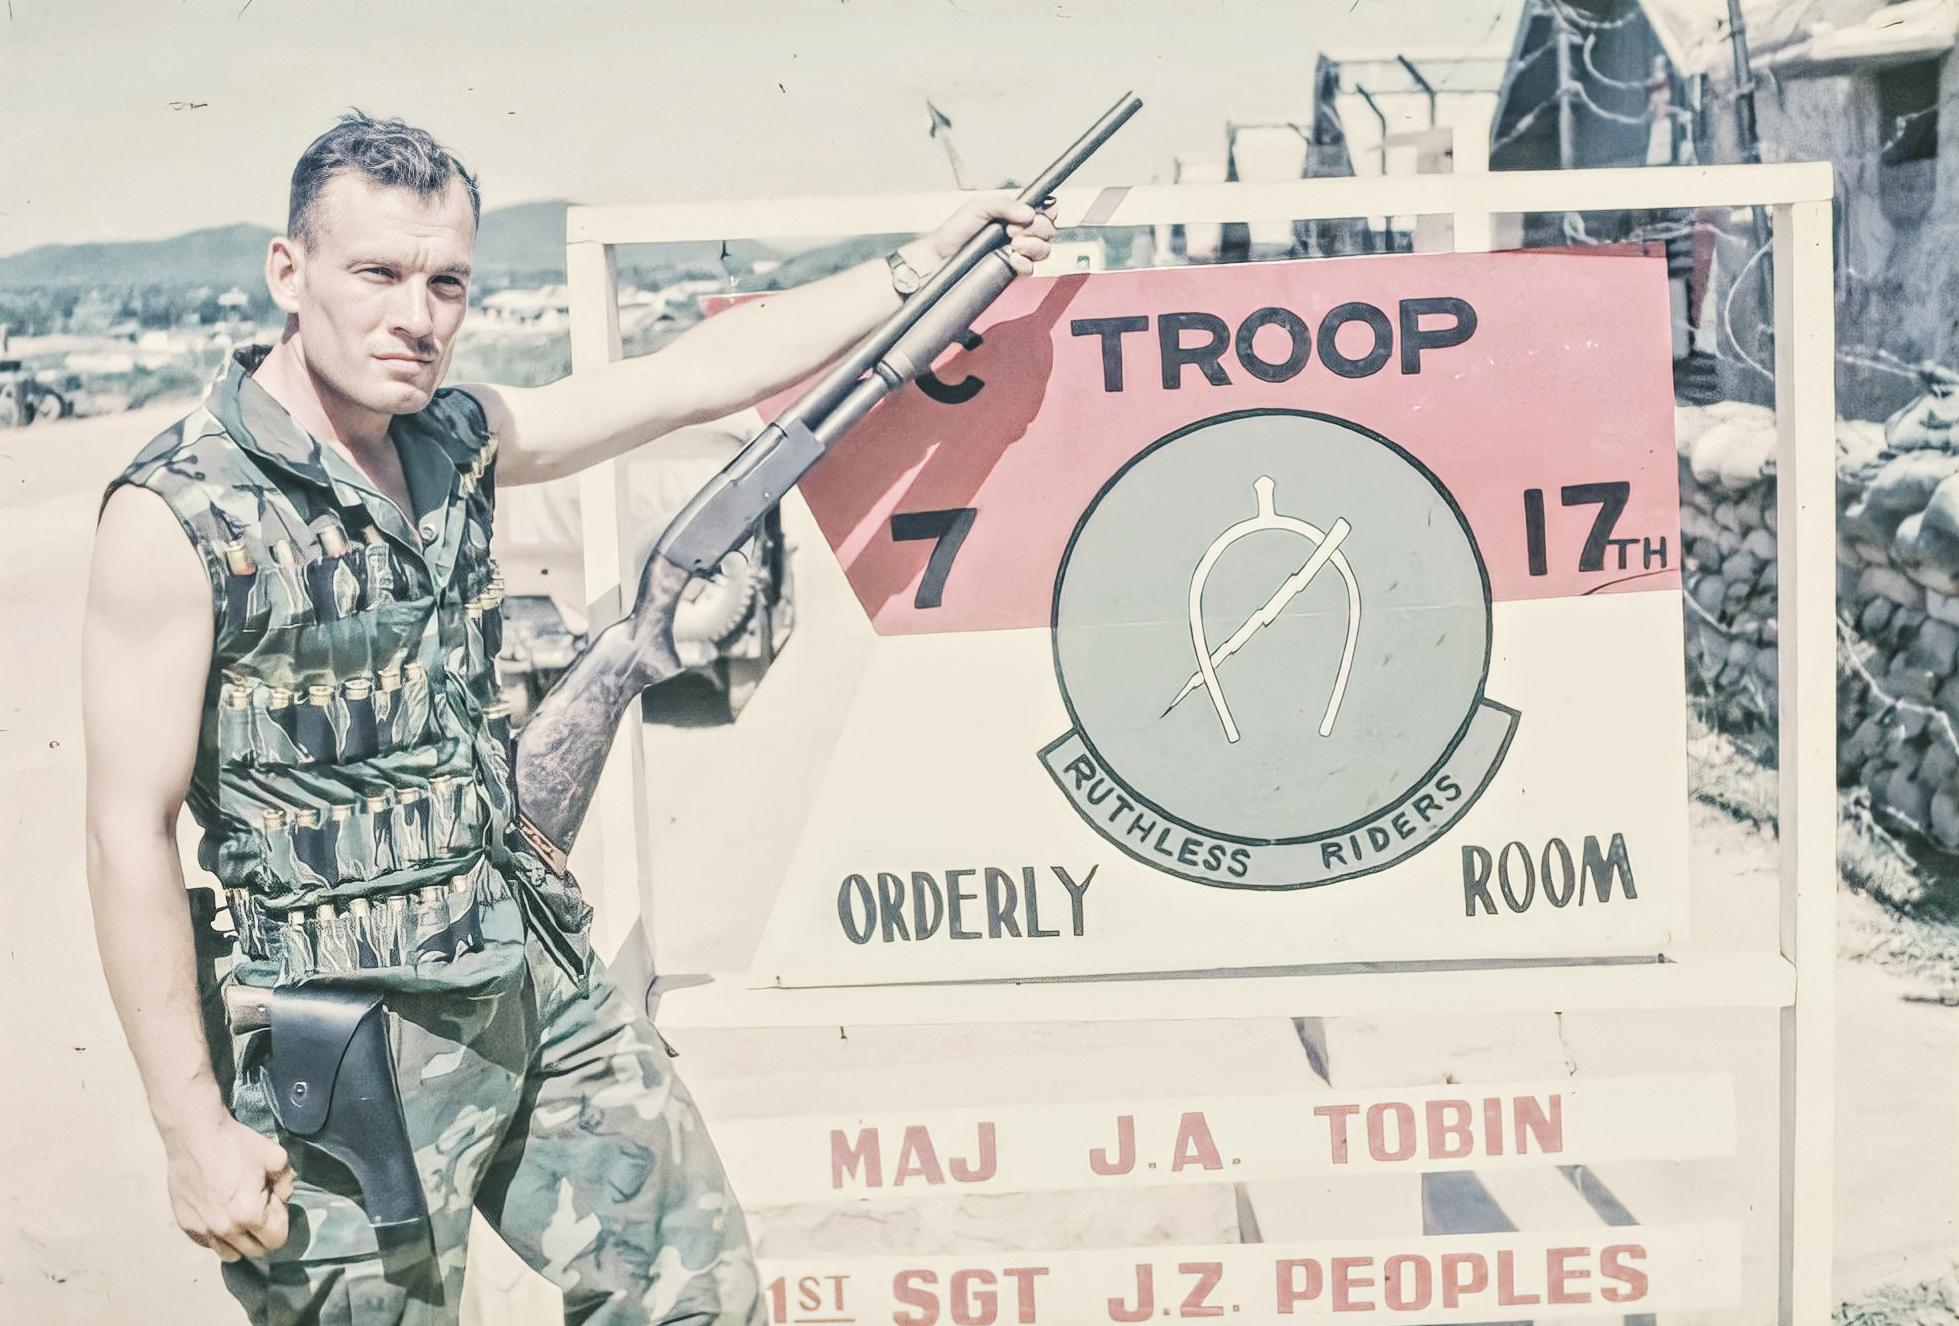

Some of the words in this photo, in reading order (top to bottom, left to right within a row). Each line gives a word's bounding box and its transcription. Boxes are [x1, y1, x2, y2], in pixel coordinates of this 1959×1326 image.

[915, 328, 986, 404] C
[1070, 297, 1478, 392] TROOP
[890, 507, 978, 609] 7
[1064, 753, 1251, 878] RUTHLESS
[1321, 774, 1463, 869] RIDERS
[839, 866, 1098, 944] ORDERLY
[1462, 833, 1637, 917] ROOM
[830, 1121, 998, 1189] MAJ
[1089, 1111, 1241, 1176] J.A.
[1313, 1094, 1564, 1165] TOBIN
[767, 1274, 856, 1324] 1ST
[892, 1266, 1050, 1326] SGT
[1107, 1261, 1241, 1323] J.Z.
[1275, 1243, 1649, 1315] PEOPLES
